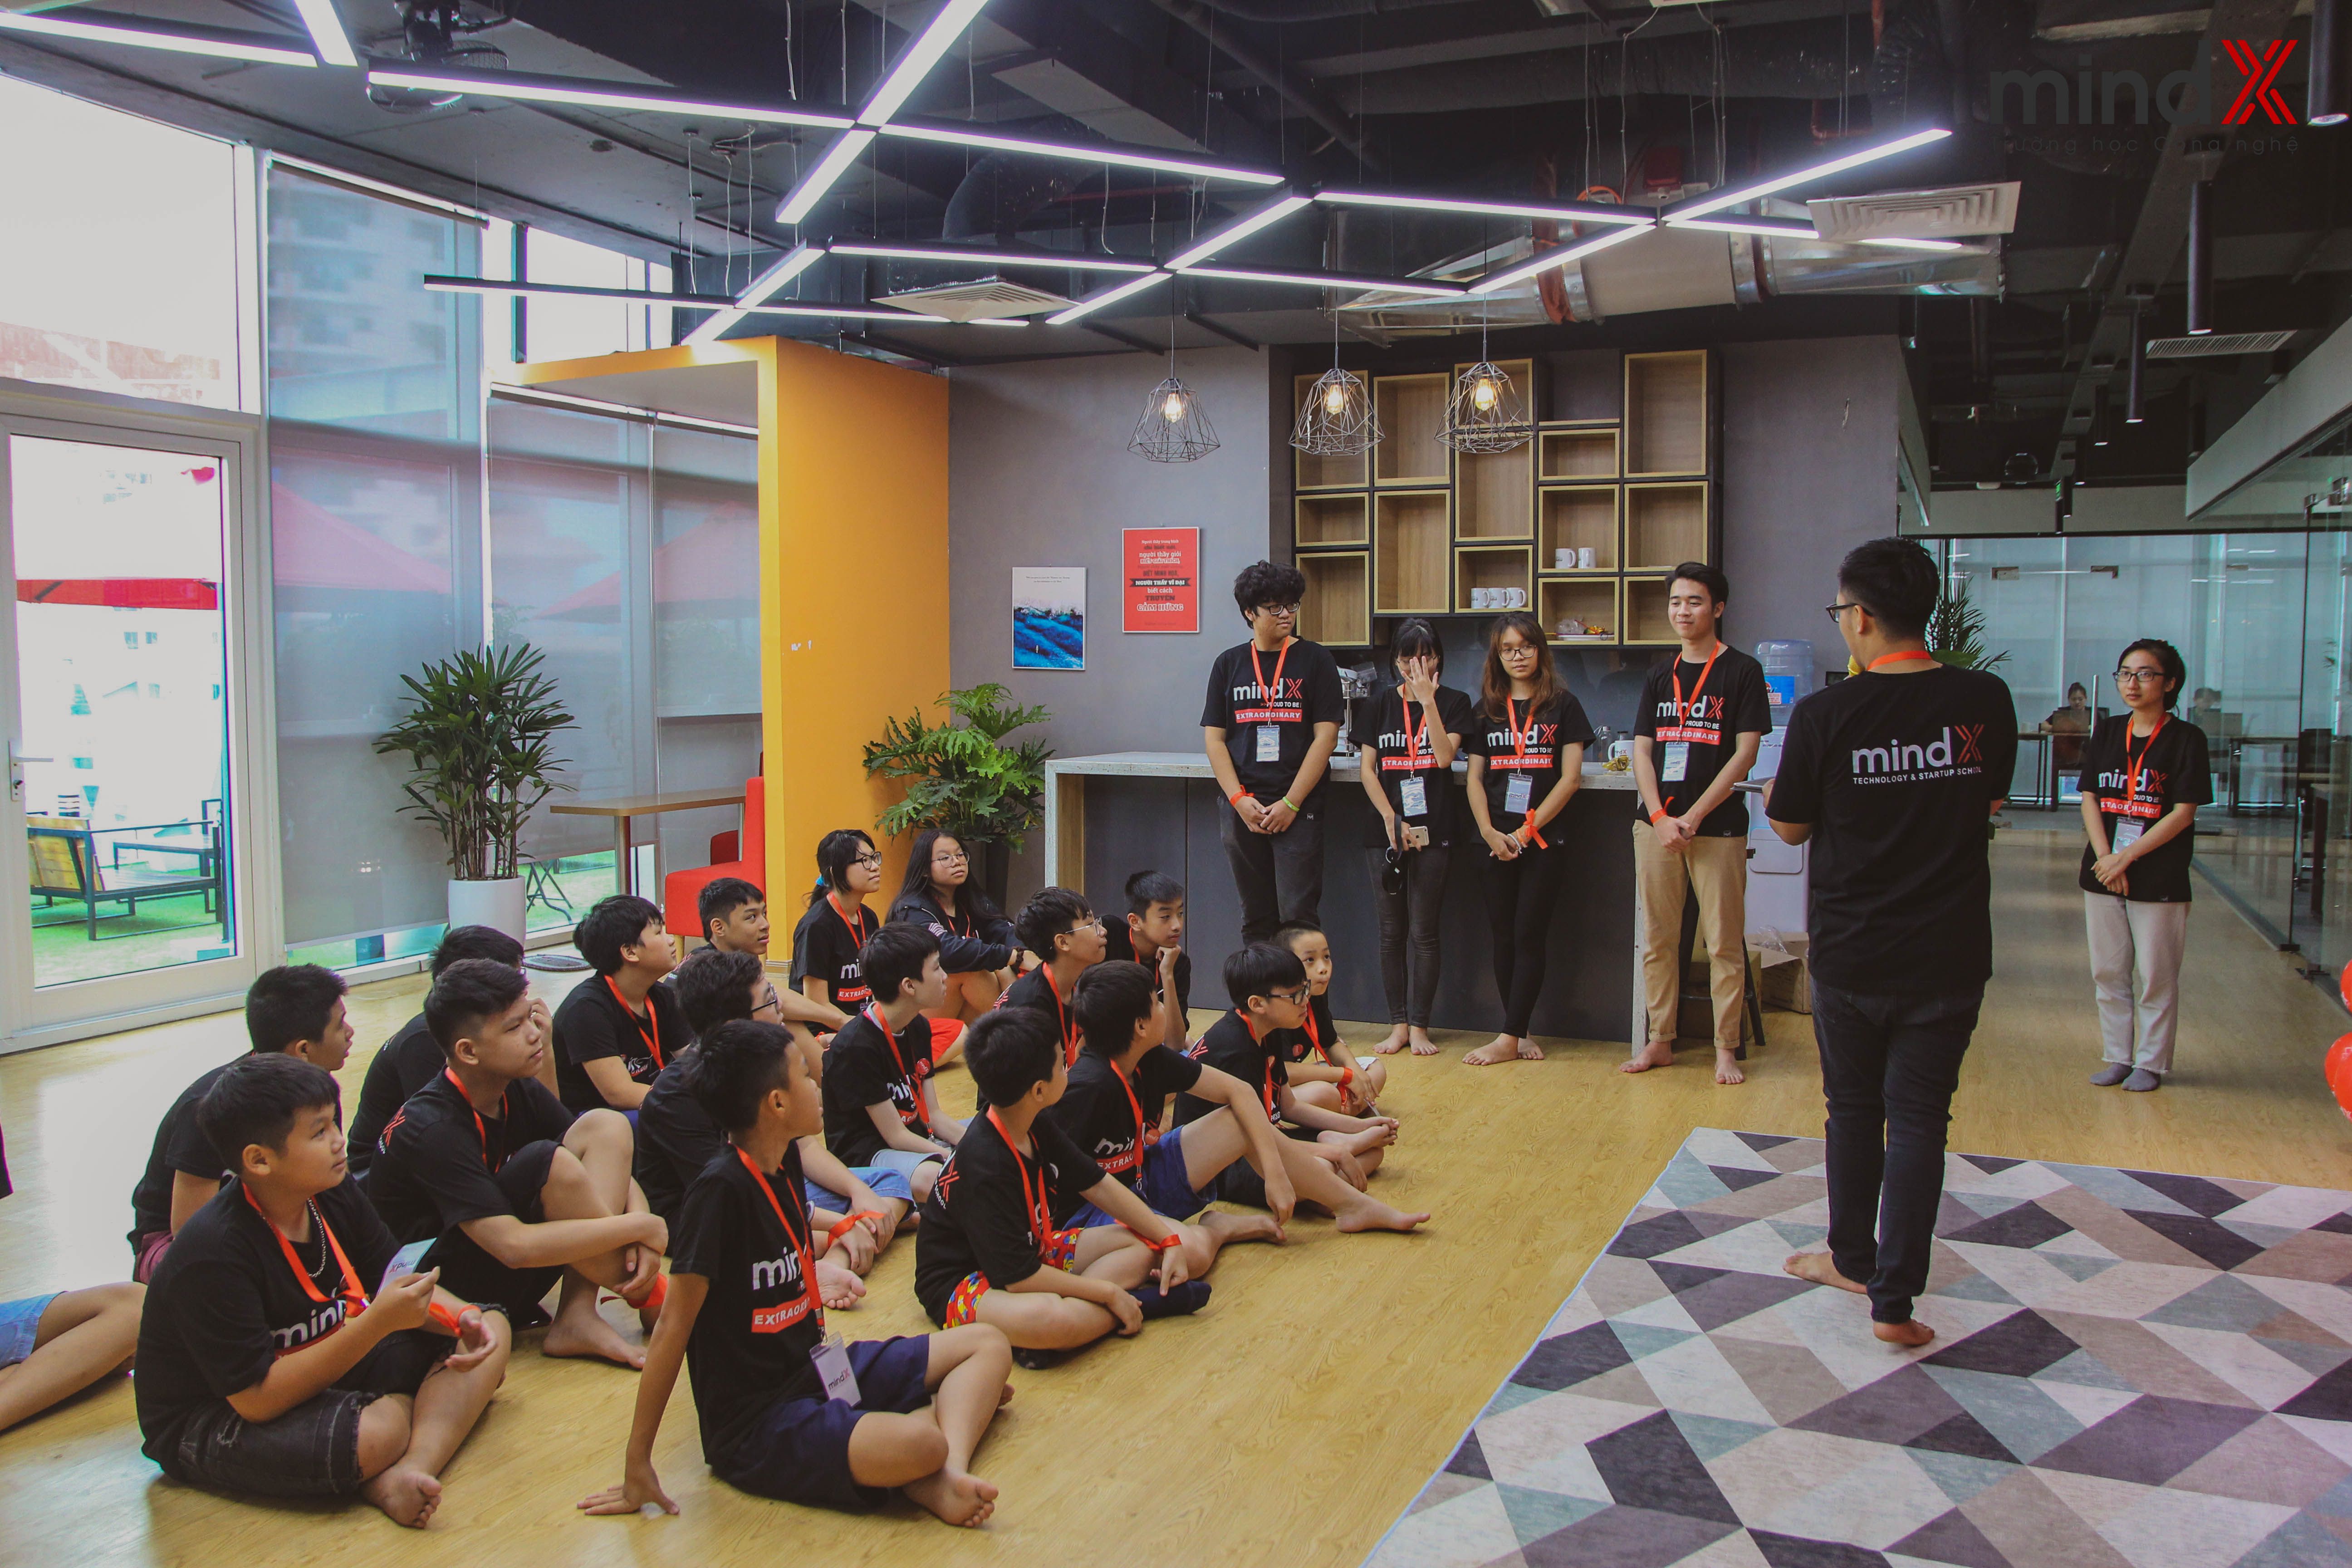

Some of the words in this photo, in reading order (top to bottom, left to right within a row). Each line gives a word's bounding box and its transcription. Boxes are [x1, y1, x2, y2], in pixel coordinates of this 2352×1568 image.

[1379, 726, 1431, 749] mind
[1852, 724, 1984, 774] mindX
[1853, 774, 1908, 784] TECHNOLOGY
[1919, 769, 1954, 780] STARTUP
[828, 1367, 851, 1391] mindX
